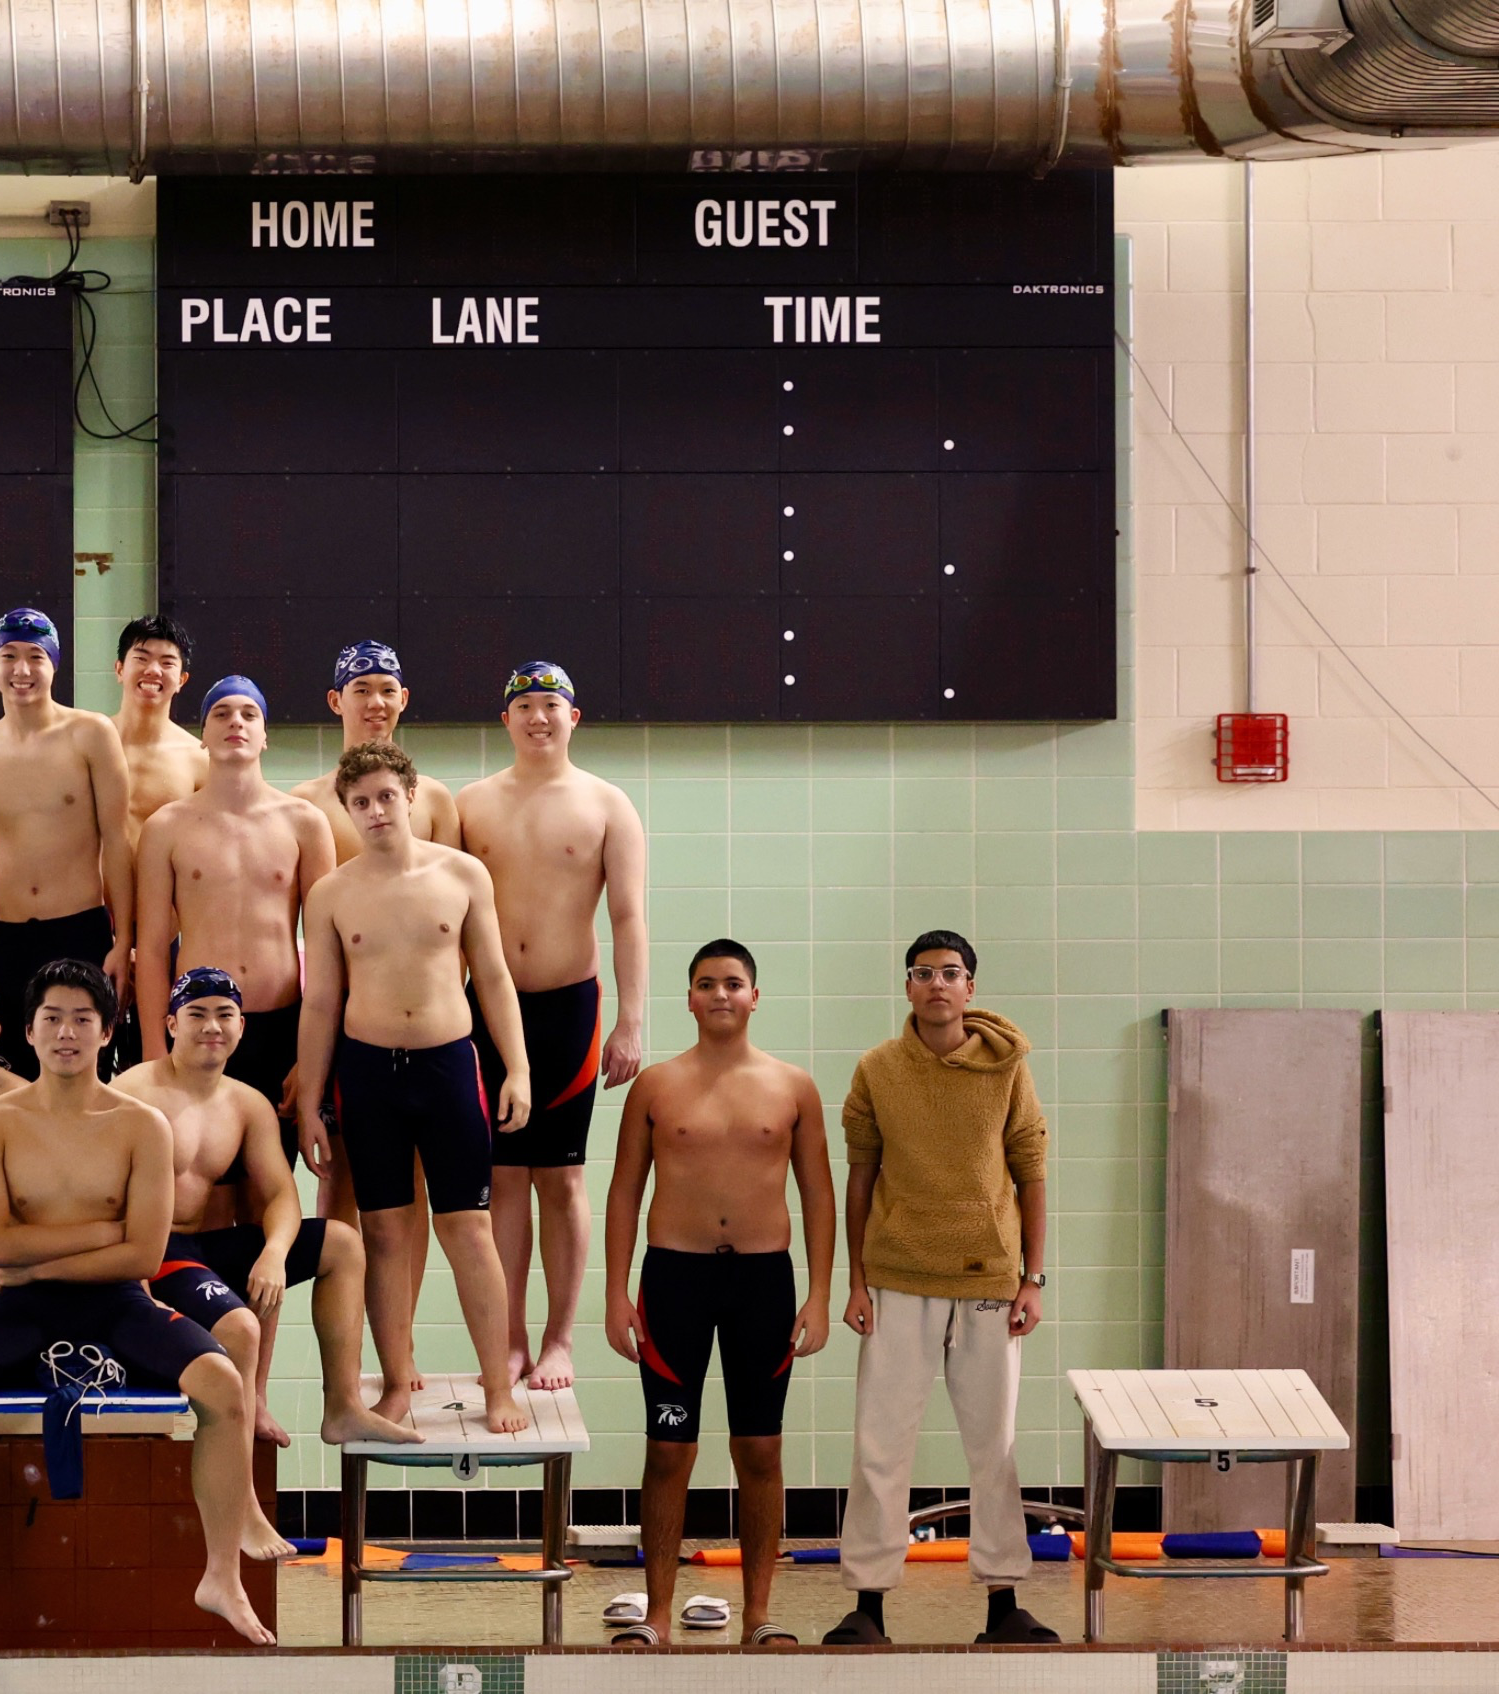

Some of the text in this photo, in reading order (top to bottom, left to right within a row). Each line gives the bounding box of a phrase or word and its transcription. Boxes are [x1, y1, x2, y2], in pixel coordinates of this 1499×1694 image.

[251, 199, 836, 248] HOME GUEST
[1012, 284, 1105, 294] DAKTRONICS
[181, 296, 881, 344] PLACE LANE TIME
[442, 1402, 467, 1411] 4
[1194, 1398, 1219, 1408] 5
[459, 1454, 471, 1475] 4
[1217, 1451, 1231, 1472] 5
